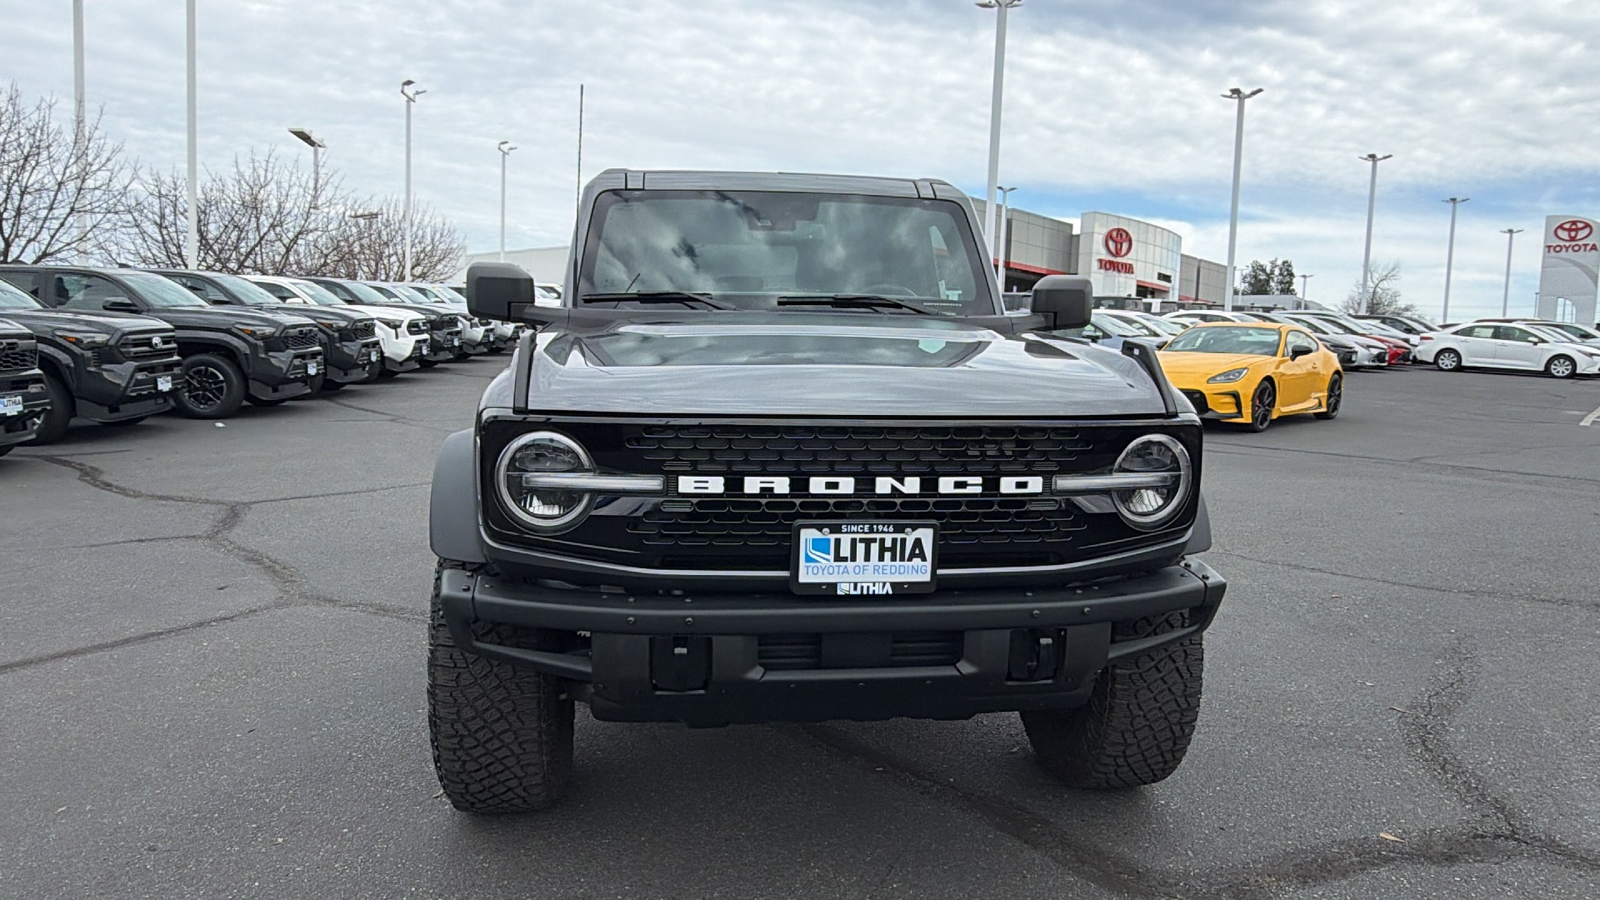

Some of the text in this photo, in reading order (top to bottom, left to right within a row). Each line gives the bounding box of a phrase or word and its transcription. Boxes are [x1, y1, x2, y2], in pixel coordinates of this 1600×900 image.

[1546, 243, 1598, 253] TOYOTA
[1098, 258, 1134, 274] TOYOTA
[678, 476, 1043, 494] BRONCO
[841, 524, 894, 533] SINCE 1946
[833, 537, 928, 563] LITHIA
[805, 565, 928, 576] TOYOTA OF REDDING
[850, 582, 893, 595] LITHIA
